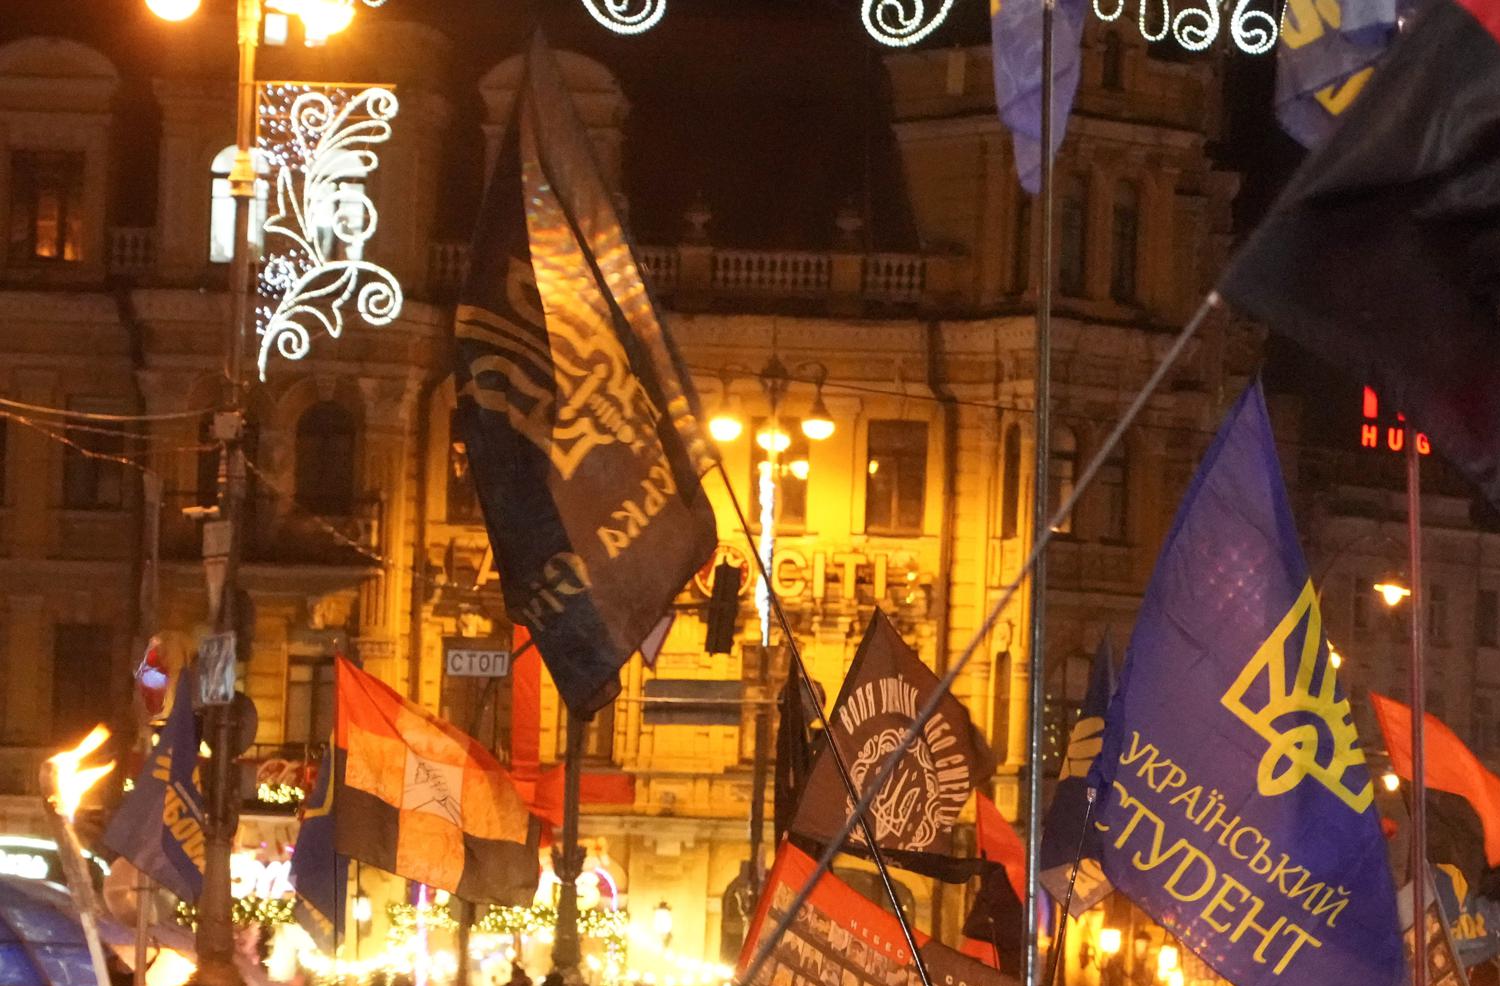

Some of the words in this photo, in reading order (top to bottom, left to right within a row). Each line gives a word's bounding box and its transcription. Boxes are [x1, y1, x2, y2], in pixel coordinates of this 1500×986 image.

[1361, 423, 1430, 455] HUG
[450, 652, 508, 673] СТОП
[838, 681, 876, 735] ВОЛЯ
[1119, 731, 1351, 928] УКРАЇНСЬКИЙ
[850, 918, 929, 972] НЕБЕСН
